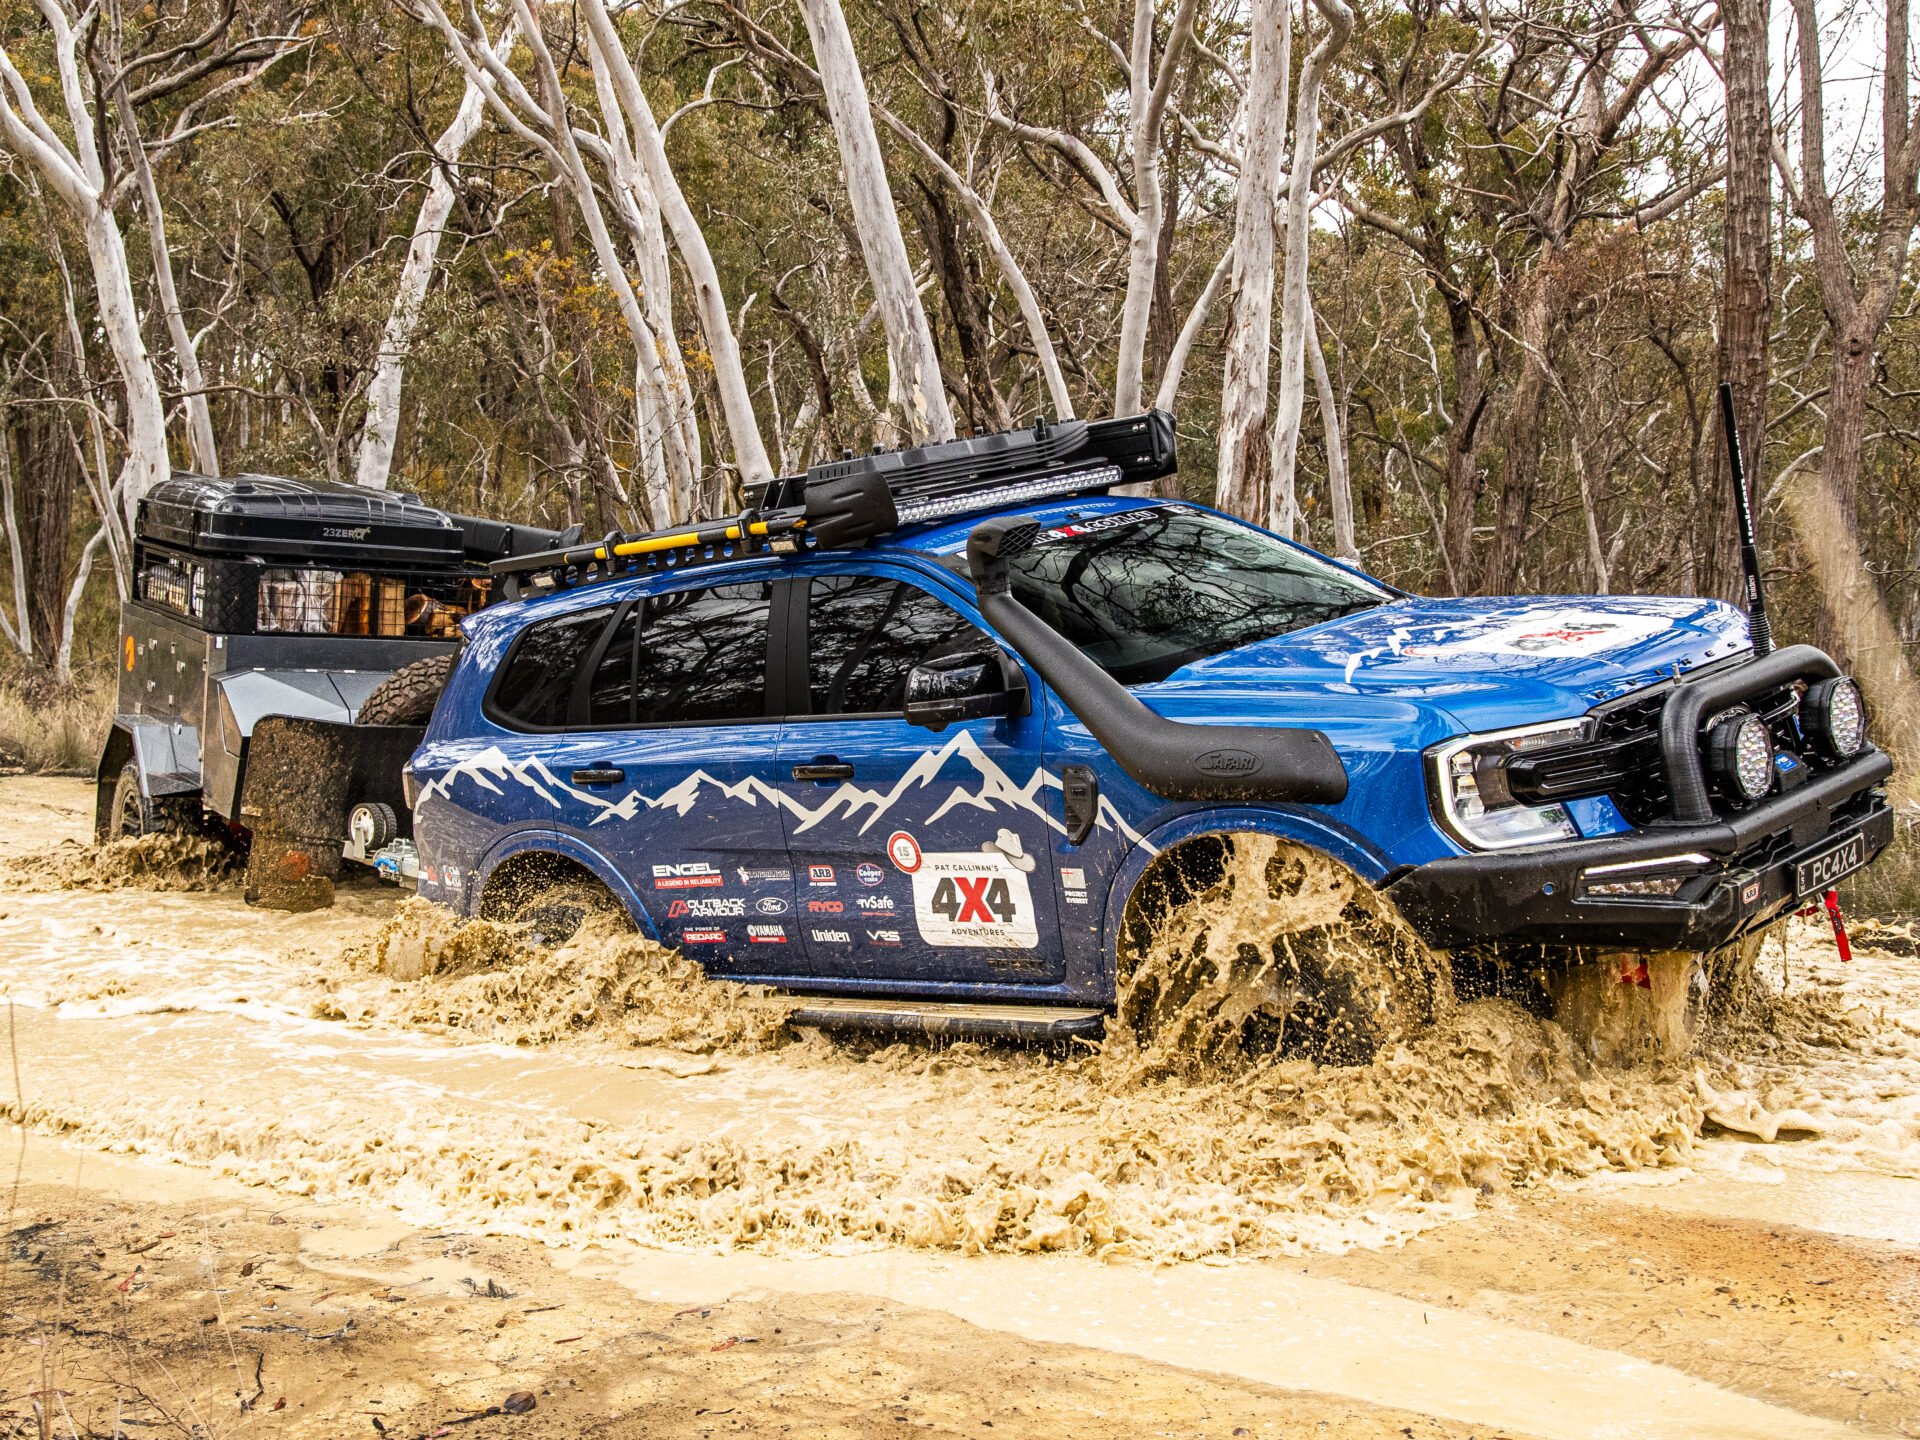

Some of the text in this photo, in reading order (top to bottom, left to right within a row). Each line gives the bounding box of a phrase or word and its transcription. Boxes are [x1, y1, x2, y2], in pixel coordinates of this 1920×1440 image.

[1032, 510, 1159, 546] R4X4.COM.AU
[1748, 574, 1758, 600] Uniden
[1594, 641, 1738, 699] EVERES
[1201, 753, 1257, 770] SAFARI
[652, 862, 721, 877] ENGEL
[953, 864, 999, 872] CALLINAN'S
[1812, 842, 1857, 886] PC4X4
[812, 868, 832, 878] ARB
[858, 868, 881, 878] Cooper
[662, 879, 683, 887] LEGEND
[690, 877, 721, 886] RELIABILITY
[1745, 886, 1757, 900] ARB
[686, 898, 746, 909] OUTBACK
[762, 900, 782, 912] Ford
[859, 895, 894, 909] rvSafe
[931, 877, 1016, 923] 4X4
[691, 907, 745, 917] ARMOUR
[808, 900, 844, 913] RYCO
[755, 924, 785, 936] YAMAHA
[811, 929, 851, 942] Uniden
[866, 929, 901, 941] VRS
[951, 928, 1005, 936] ADVENTURES
[686, 932, 723, 941] REDARC
